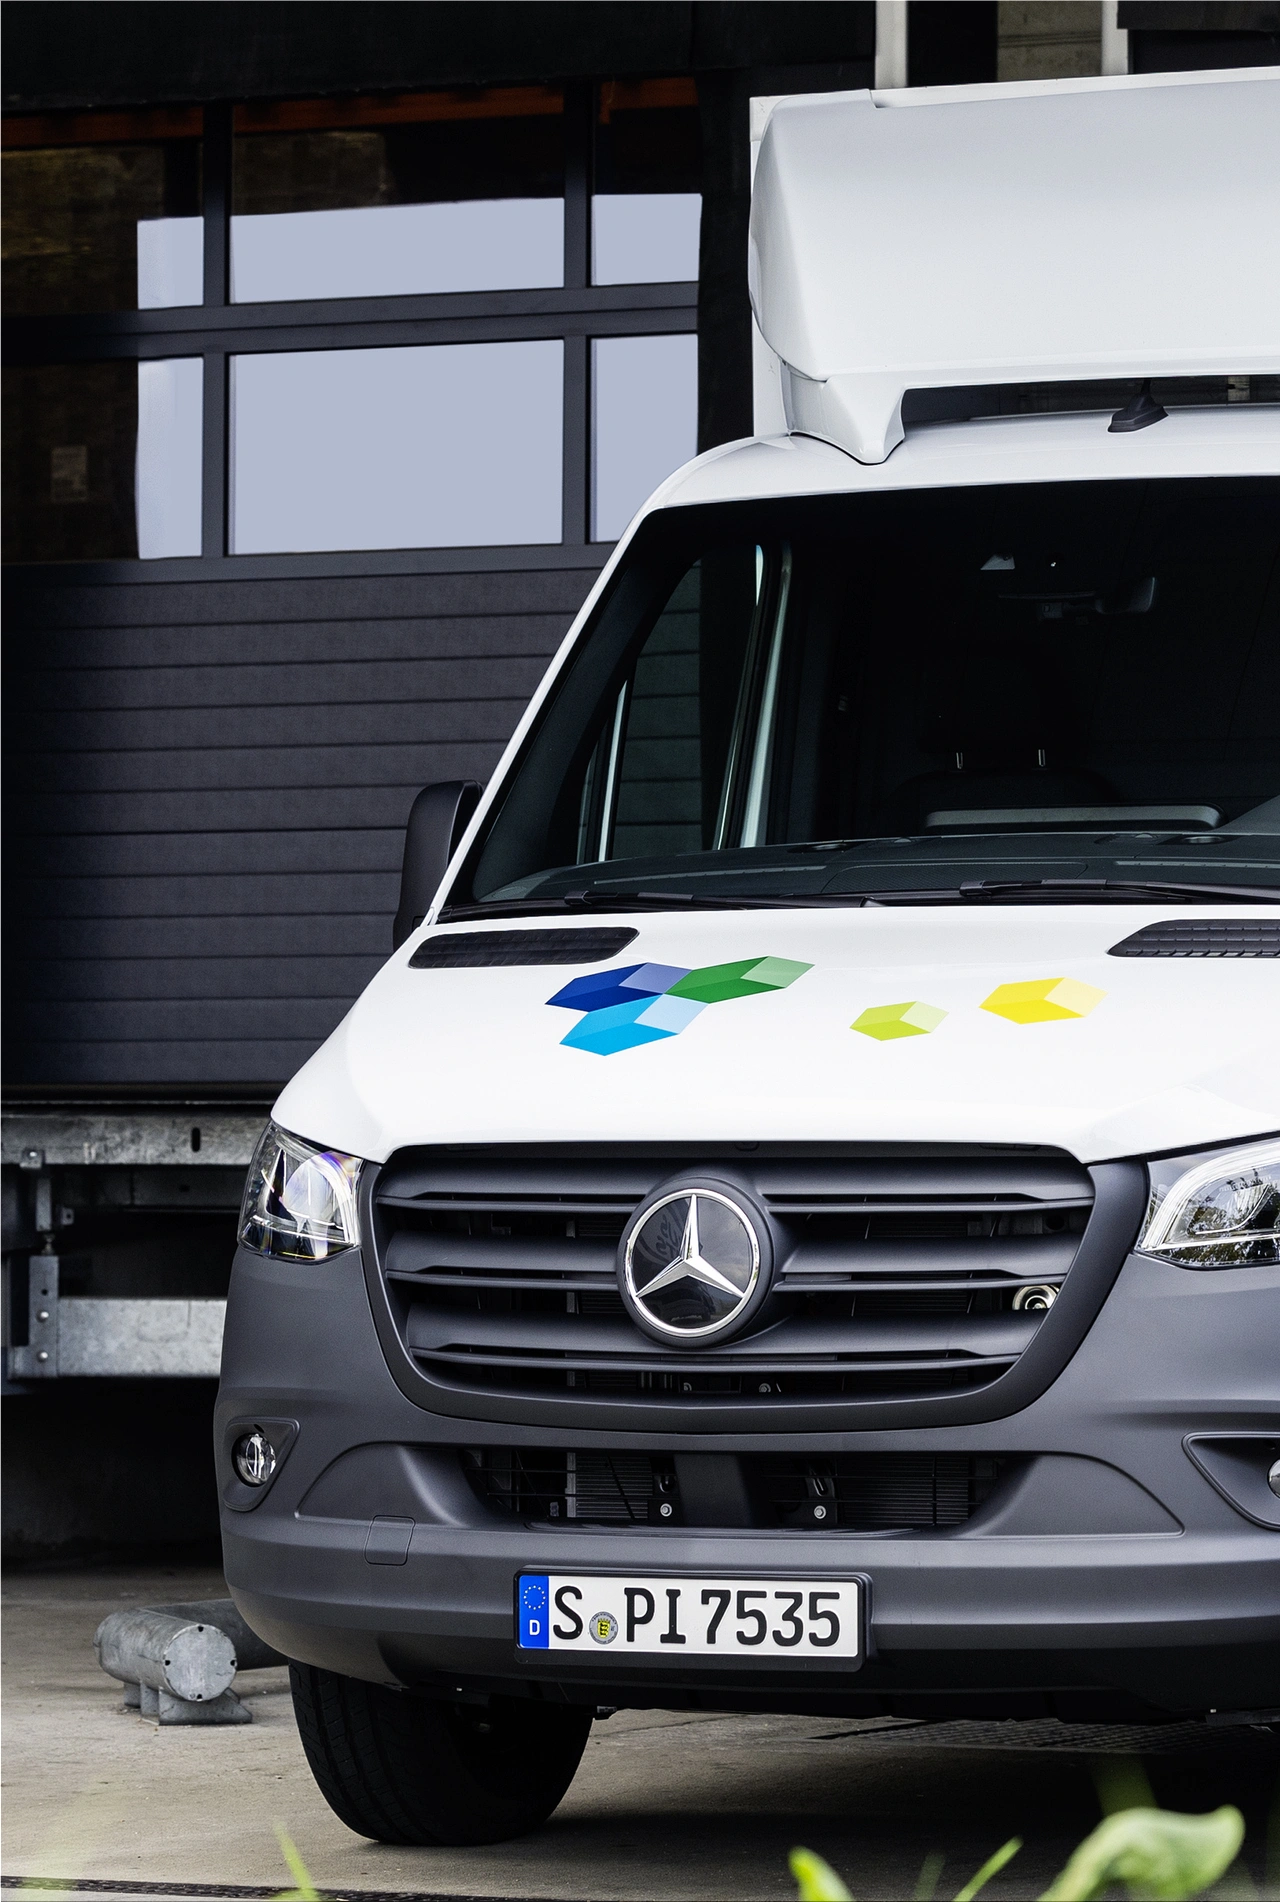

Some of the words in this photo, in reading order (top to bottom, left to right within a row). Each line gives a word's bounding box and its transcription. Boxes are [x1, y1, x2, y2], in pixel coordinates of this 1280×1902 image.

[529, 1619, 541, 1637] D
[553, 1585, 583, 1640] S
[624, 1587, 686, 1645] PI
[701, 1588, 840, 1648] 7535
